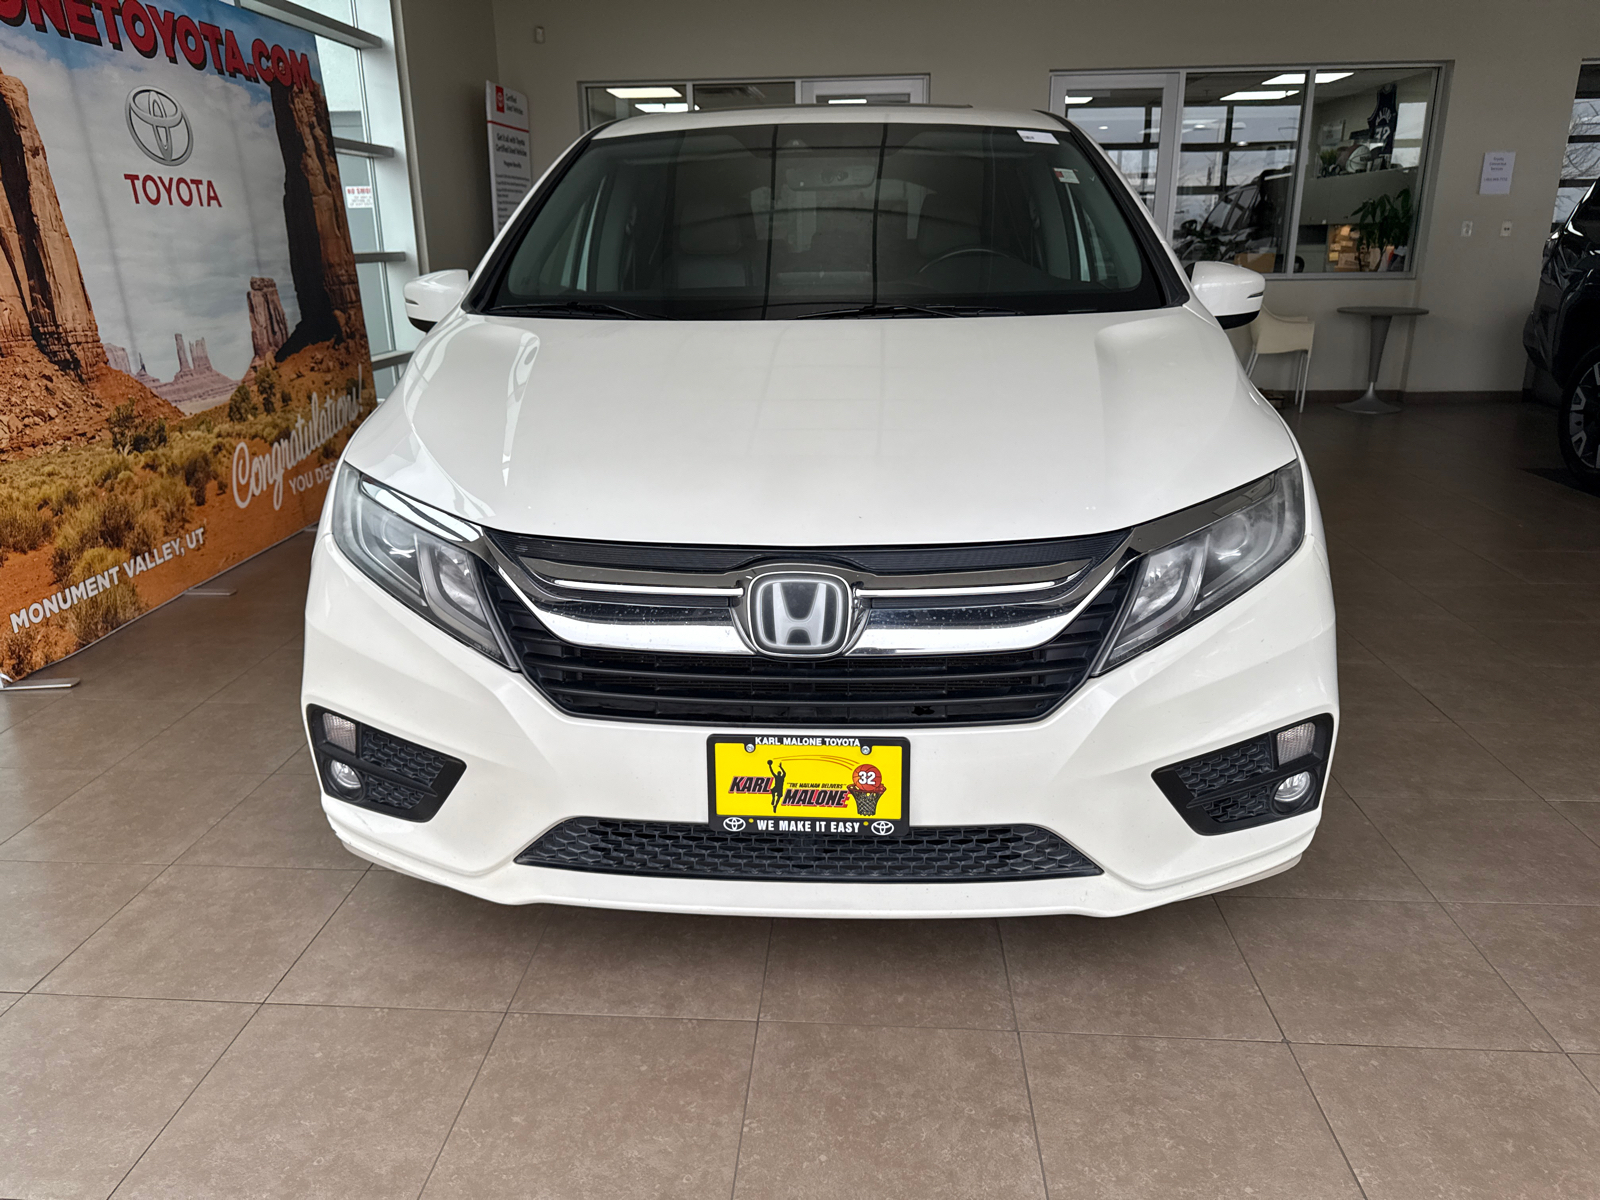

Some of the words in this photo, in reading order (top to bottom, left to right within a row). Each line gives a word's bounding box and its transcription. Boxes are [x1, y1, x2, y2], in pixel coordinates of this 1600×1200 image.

[123, 173, 222, 208] TOYOTA
[232, 363, 363, 511] Congratulations!
[289, 471, 314, 495] YOU
[315, 462, 338, 484] DES
[9, 566, 120, 634] MONUMENT
[123, 537, 185, 579] VALLEY,
[186, 527, 205, 549] UT
[755, 737, 780, 745] KARL
[783, 738, 823, 746] MALONE
[824, 738, 860, 747] TOYOTA
[728, 776, 774, 794] KARL
[858, 771, 876, 785] 32
[781, 788, 850, 808] MALONE
[757, 820, 775, 831] WE
[779, 820, 812, 832] MAKE
[816, 821, 828, 832] IT
[831, 821, 860, 833] EASY
